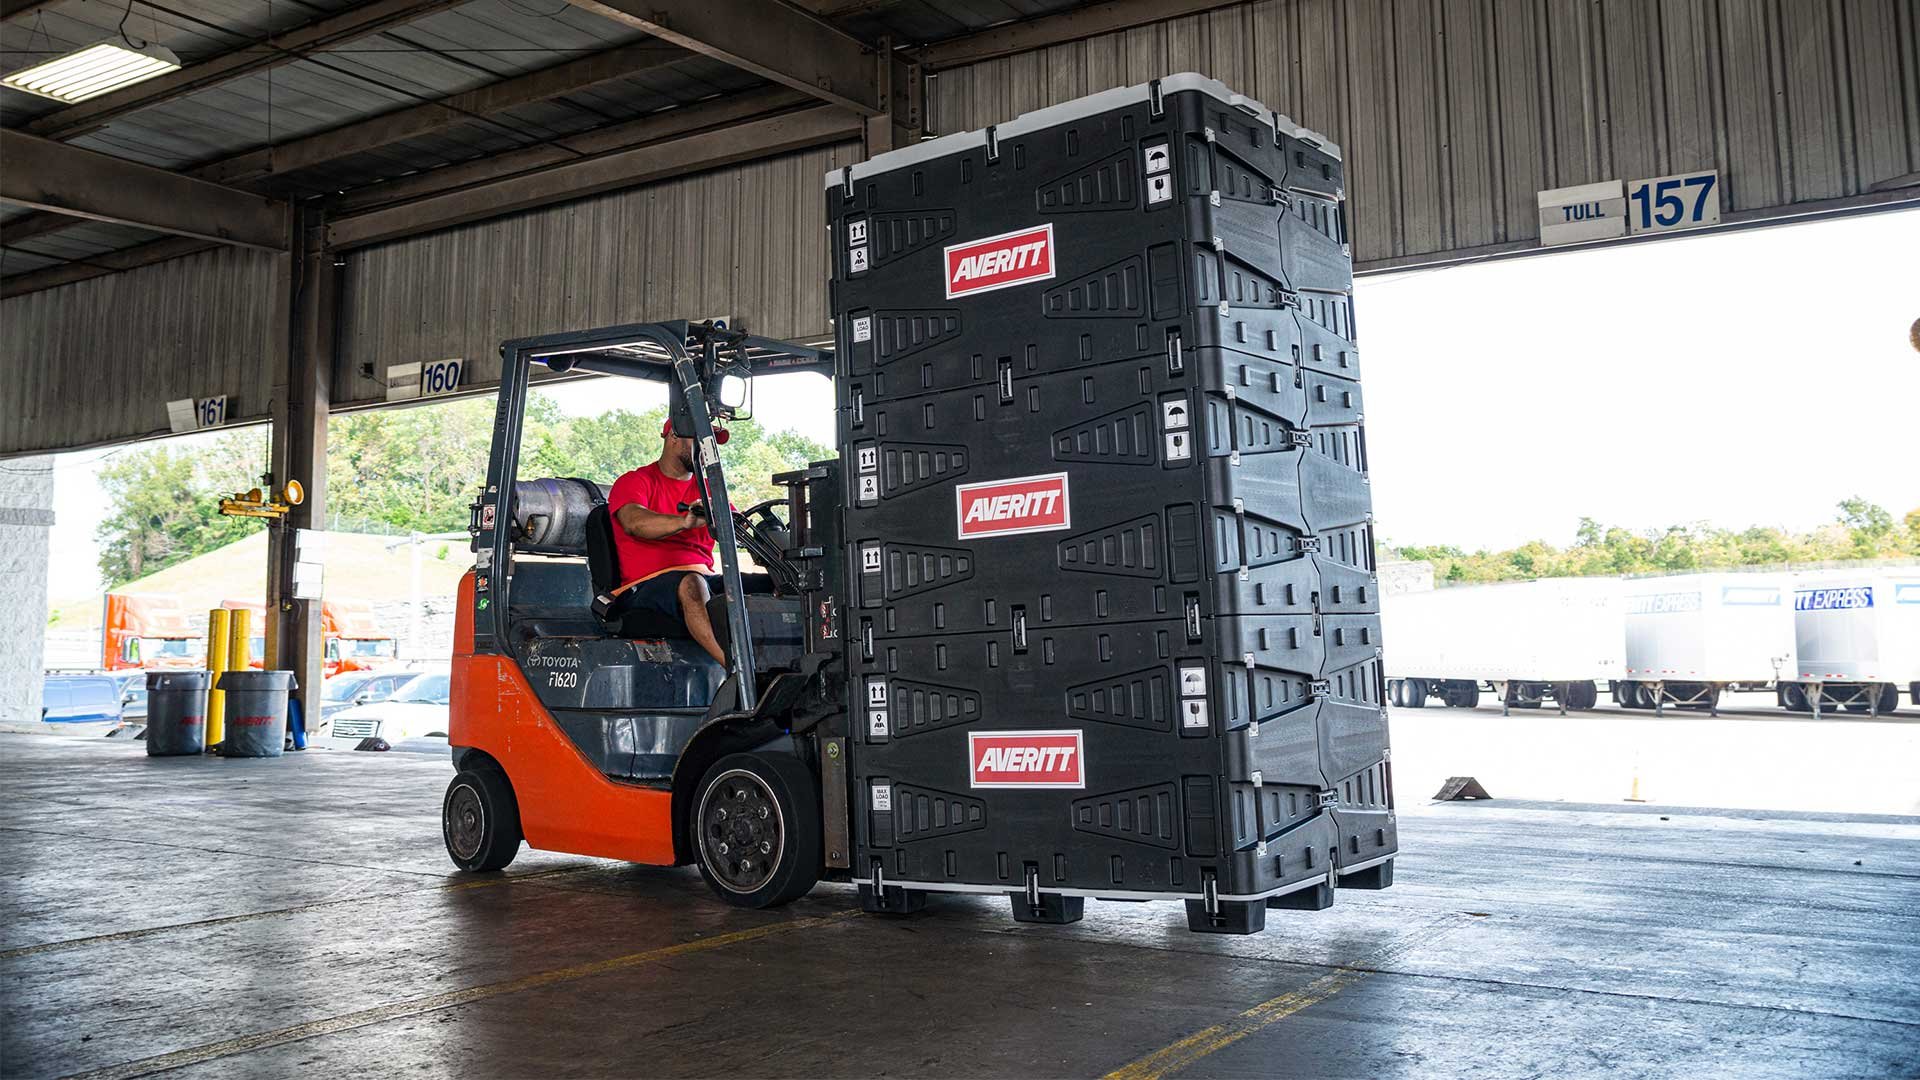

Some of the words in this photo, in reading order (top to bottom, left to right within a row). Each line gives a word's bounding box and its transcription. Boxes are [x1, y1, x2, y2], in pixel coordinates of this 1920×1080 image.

[1562, 202, 1605, 222] TULL
[1631, 174, 1716, 229] 157
[952, 240, 1046, 283] AVERITT
[425, 361, 459, 393] 160
[200, 398, 225, 427] 161
[964, 489, 1061, 524] AVERITT
[1813, 588, 1870, 609] EXPRESS
[542, 656, 578, 668] TOYOTA
[548, 672, 577, 688] F1620
[976, 746, 1076, 773] AVERITT
